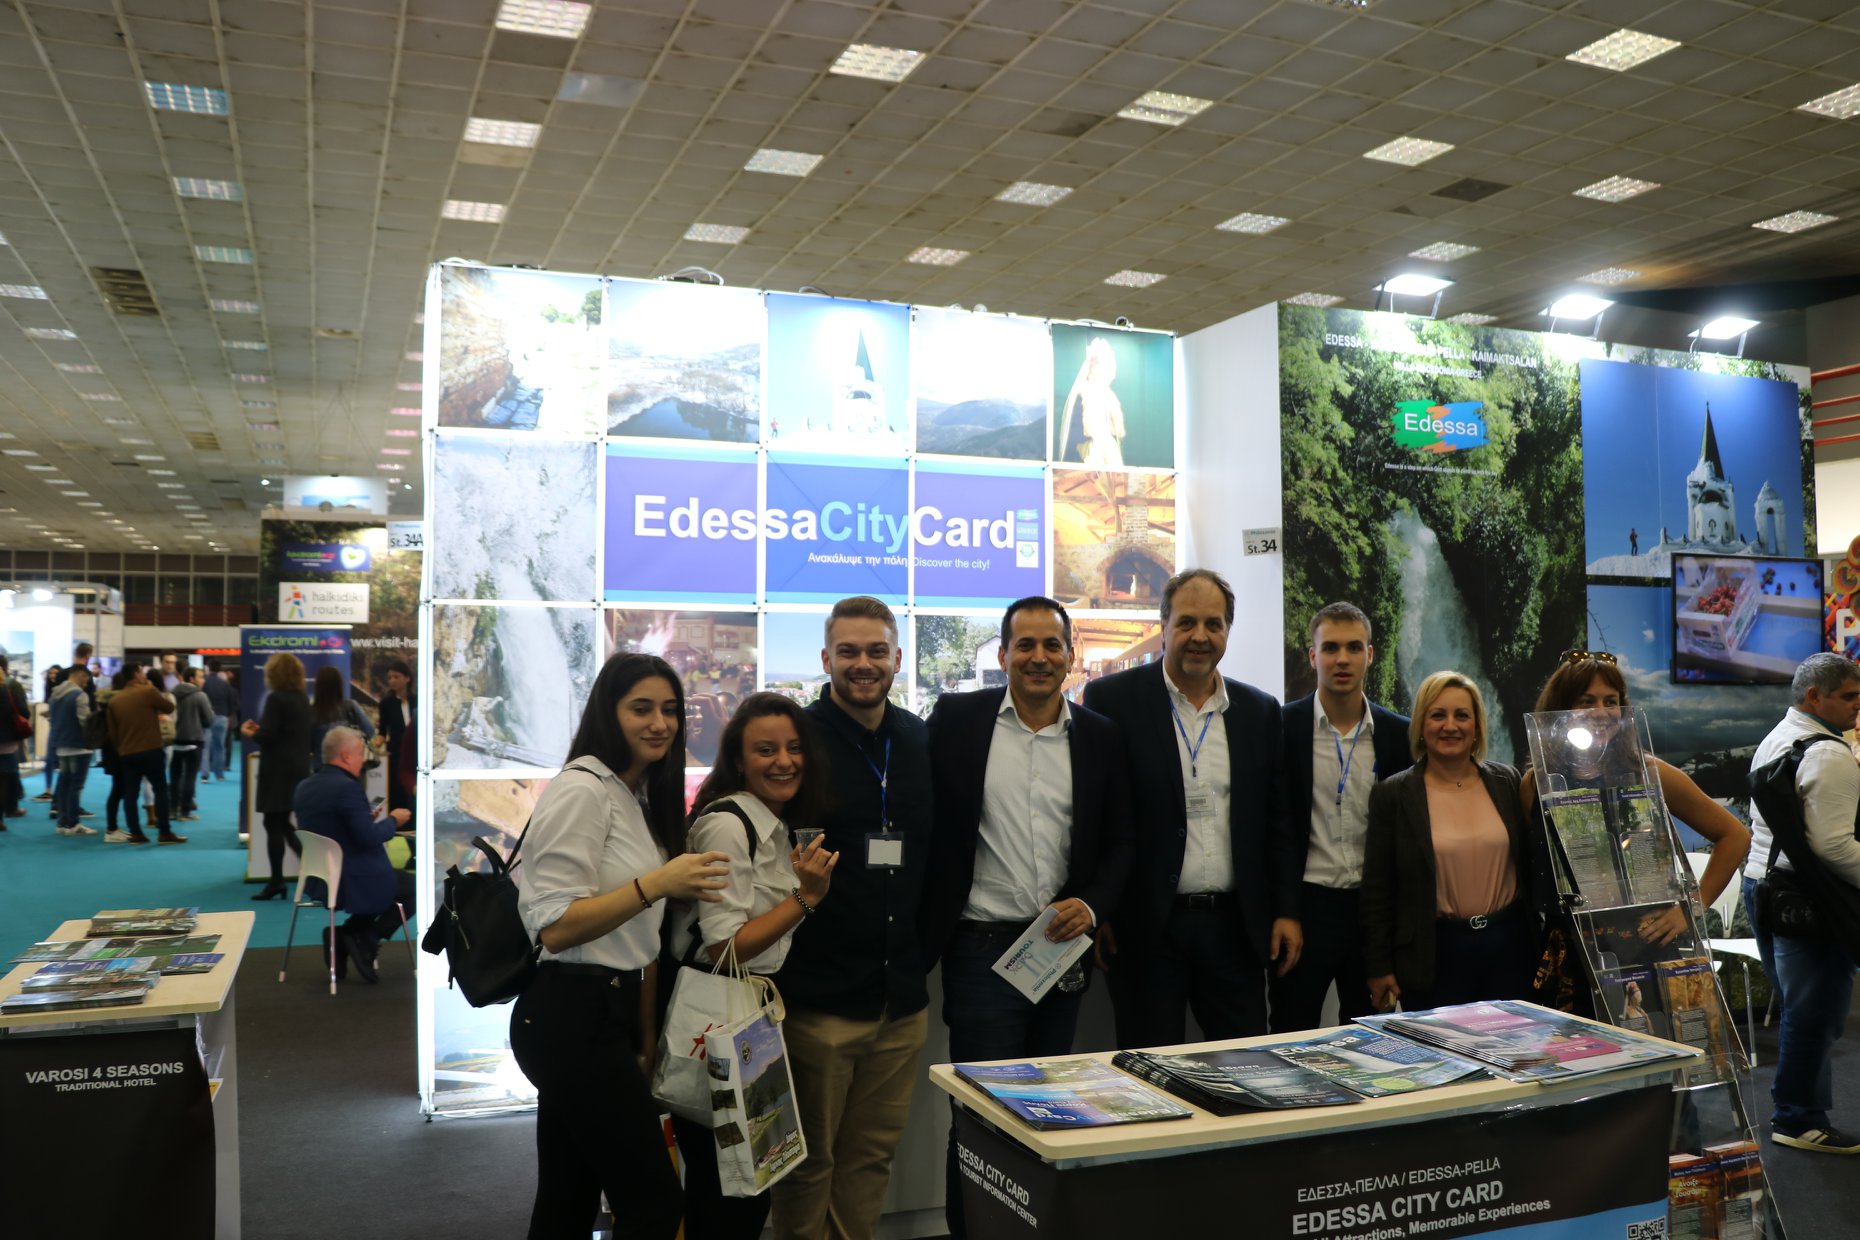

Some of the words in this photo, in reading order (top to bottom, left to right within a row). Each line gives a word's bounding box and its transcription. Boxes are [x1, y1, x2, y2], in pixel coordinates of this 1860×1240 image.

[1326, 333, 1363, 349] EDESSA
[1471, 349, 1537, 369] KAIMAKTSALAN
[1404, 413, 1478, 436] Edessa
[807, 552, 862, 566] Ανακάλυψε
[865, 556, 881, 567] την
[913, 557, 951, 568] Discover
[955, 558, 969, 568] the
[971, 559, 990, 571] city!
[312, 605, 354, 615] routes
[1003, 940, 1034, 970] TOURISM
[25, 1070, 89, 1084] VAROSI
[92, 1067, 103, 1079] 4
[106, 1062, 184, 1078] SEASONS
[55, 1080, 122, 1092] TRADITIONAL
[123, 1078, 157, 1088] HOTEL
[962, 1164, 984, 1186] TOURIST
[982, 1179, 1017, 1212] INFORMATION
[1016, 1205, 1038, 1228] CENTER
[986, 1164, 1006, 1187] CITY
[1006, 1178, 1029, 1206] CARD
[1297, 1173, 1400, 1203] ΕΔΕΣΣΑ-ΠΕΛΛΑ
[1408, 1156, 1501, 1185] EDESSA-PELLA
[1292, 1201, 1387, 1235] EDESSA
[1391, 1191, 1441, 1218] CITY
[1446, 1180, 1504, 1209] CARD
[1409, 1211, 1476, 1235] Memorable
[1478, 1199, 1551, 1222] Experiences
